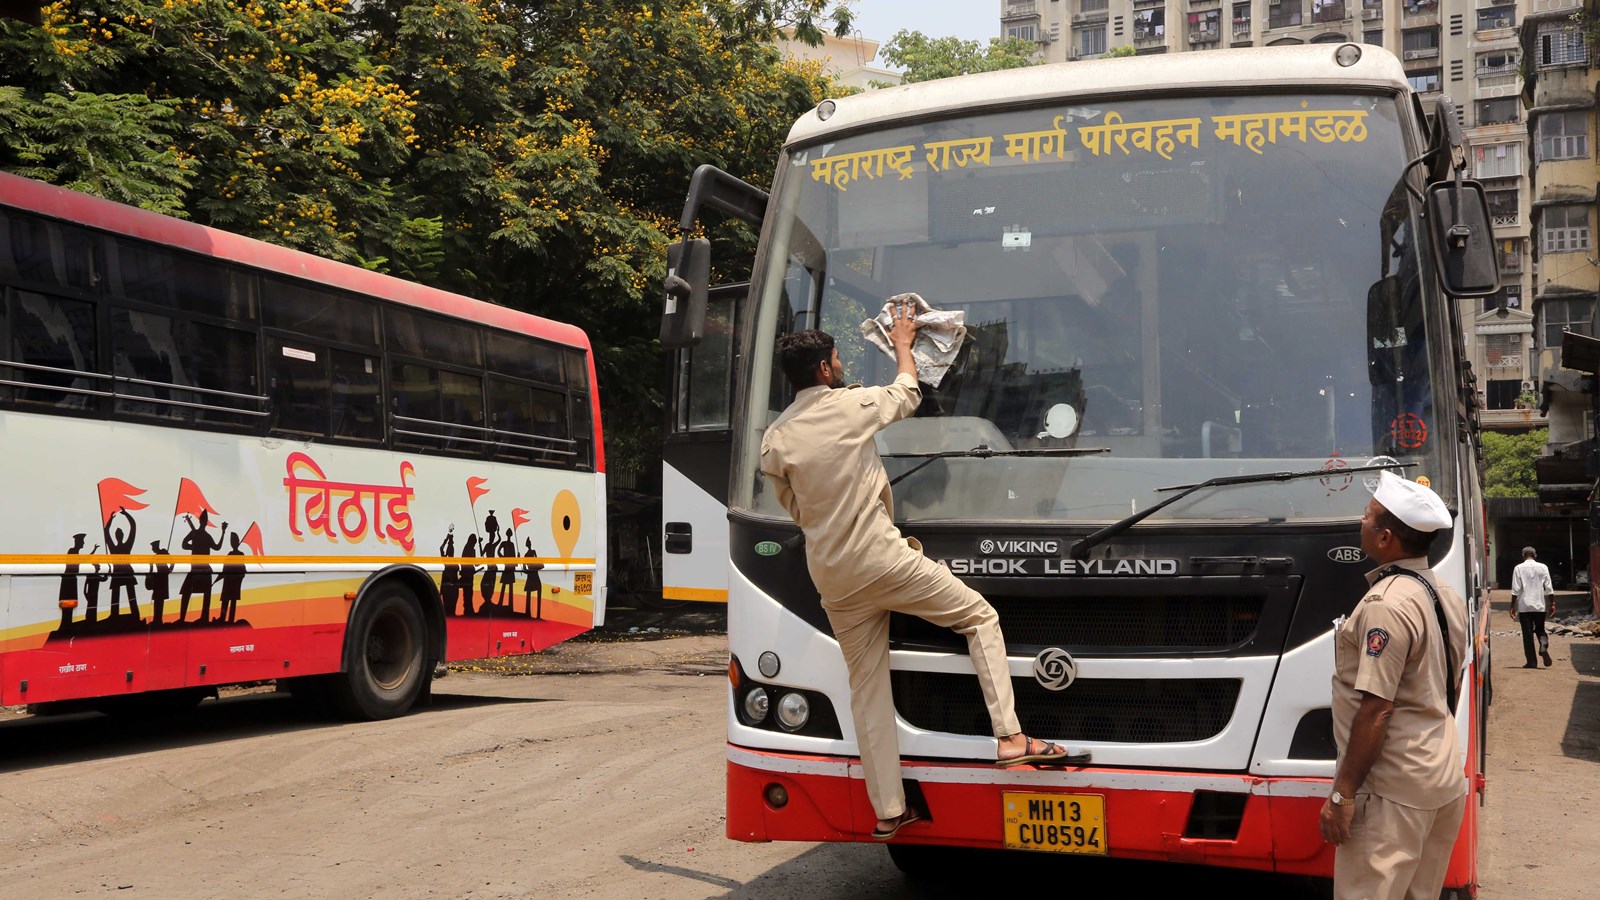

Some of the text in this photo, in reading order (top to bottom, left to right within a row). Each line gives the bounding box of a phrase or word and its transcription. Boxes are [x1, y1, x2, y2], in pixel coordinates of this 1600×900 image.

[810, 99, 1369, 192] महाराष्ट्र राज्य मार्ग परिवहन महामंडळ
[283, 452, 416, 556] विठाई
[758, 544, 777, 553] BS IV
[996, 541, 1058, 553] VIKING
[1334, 549, 1361, 561] ABS
[1044, 559, 1177, 575] LEYLAND
[1048, 662, 1062, 675] L
[1028, 799, 1081, 822] MH13
[1019, 823, 1099, 848] CU8594
